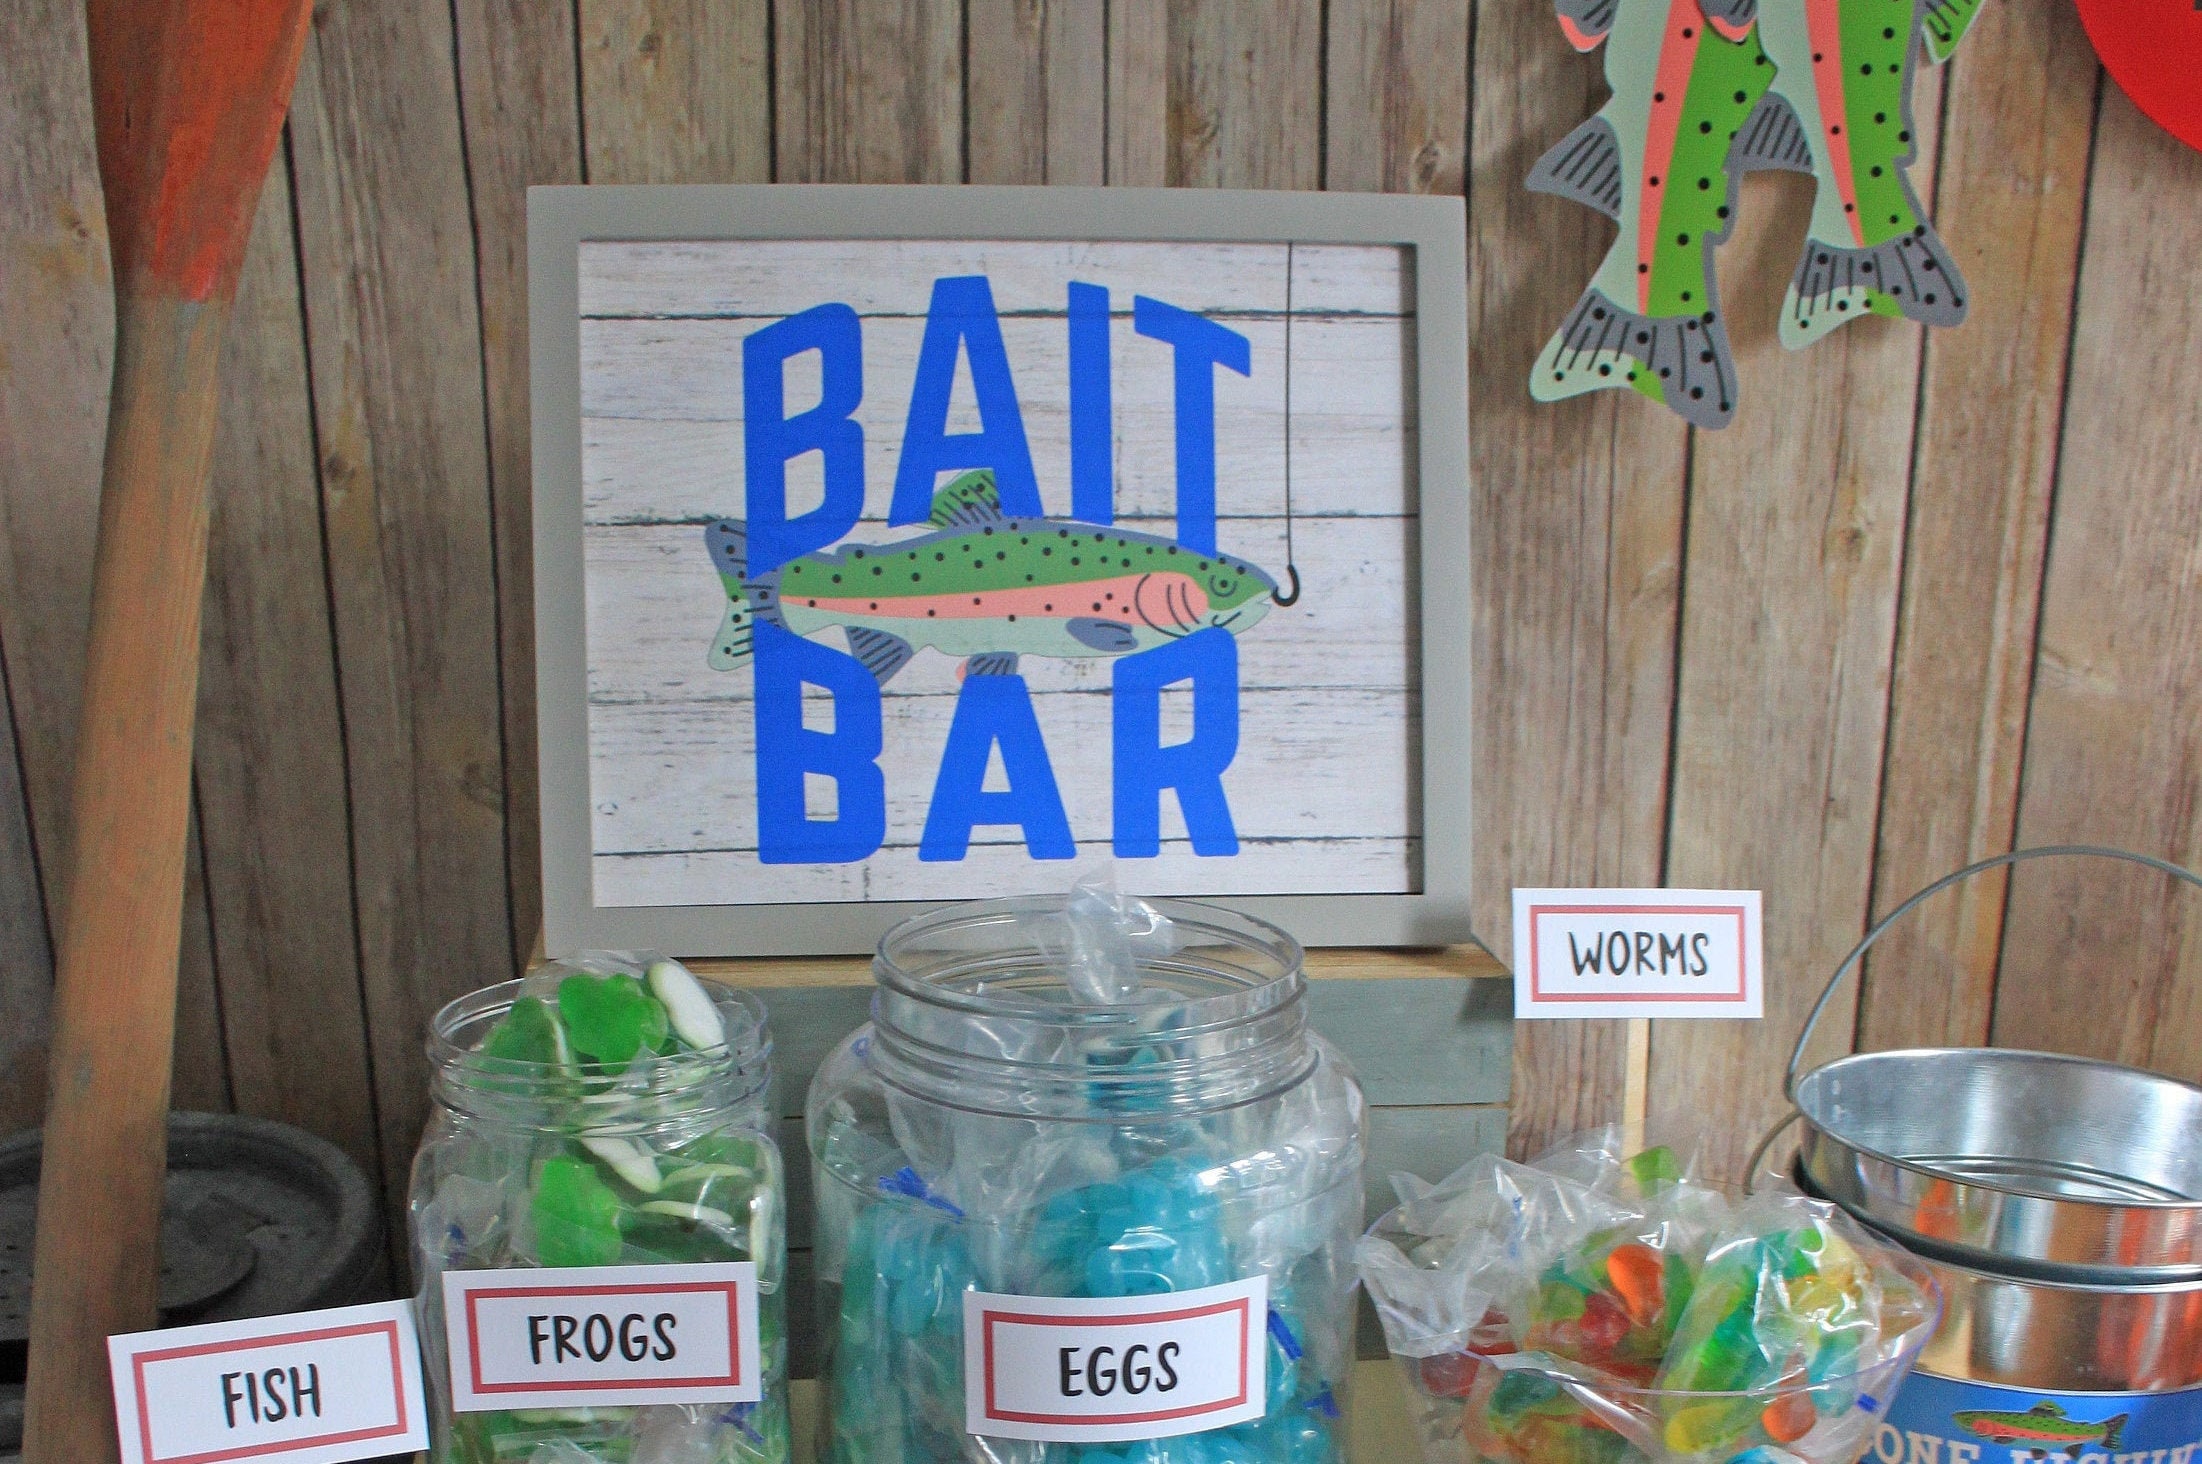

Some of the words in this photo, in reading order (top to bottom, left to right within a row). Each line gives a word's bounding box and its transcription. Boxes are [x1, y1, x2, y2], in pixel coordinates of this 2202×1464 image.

[743, 275, 1251, 581] BAIT
[752, 618, 1240, 865] BAR
[1569, 930, 1708, 978] WORMS
[527, 1312, 677, 1365] FROGS
[1059, 1341, 1180, 1397] EGGS
[221, 1363, 321, 1429] FISH
